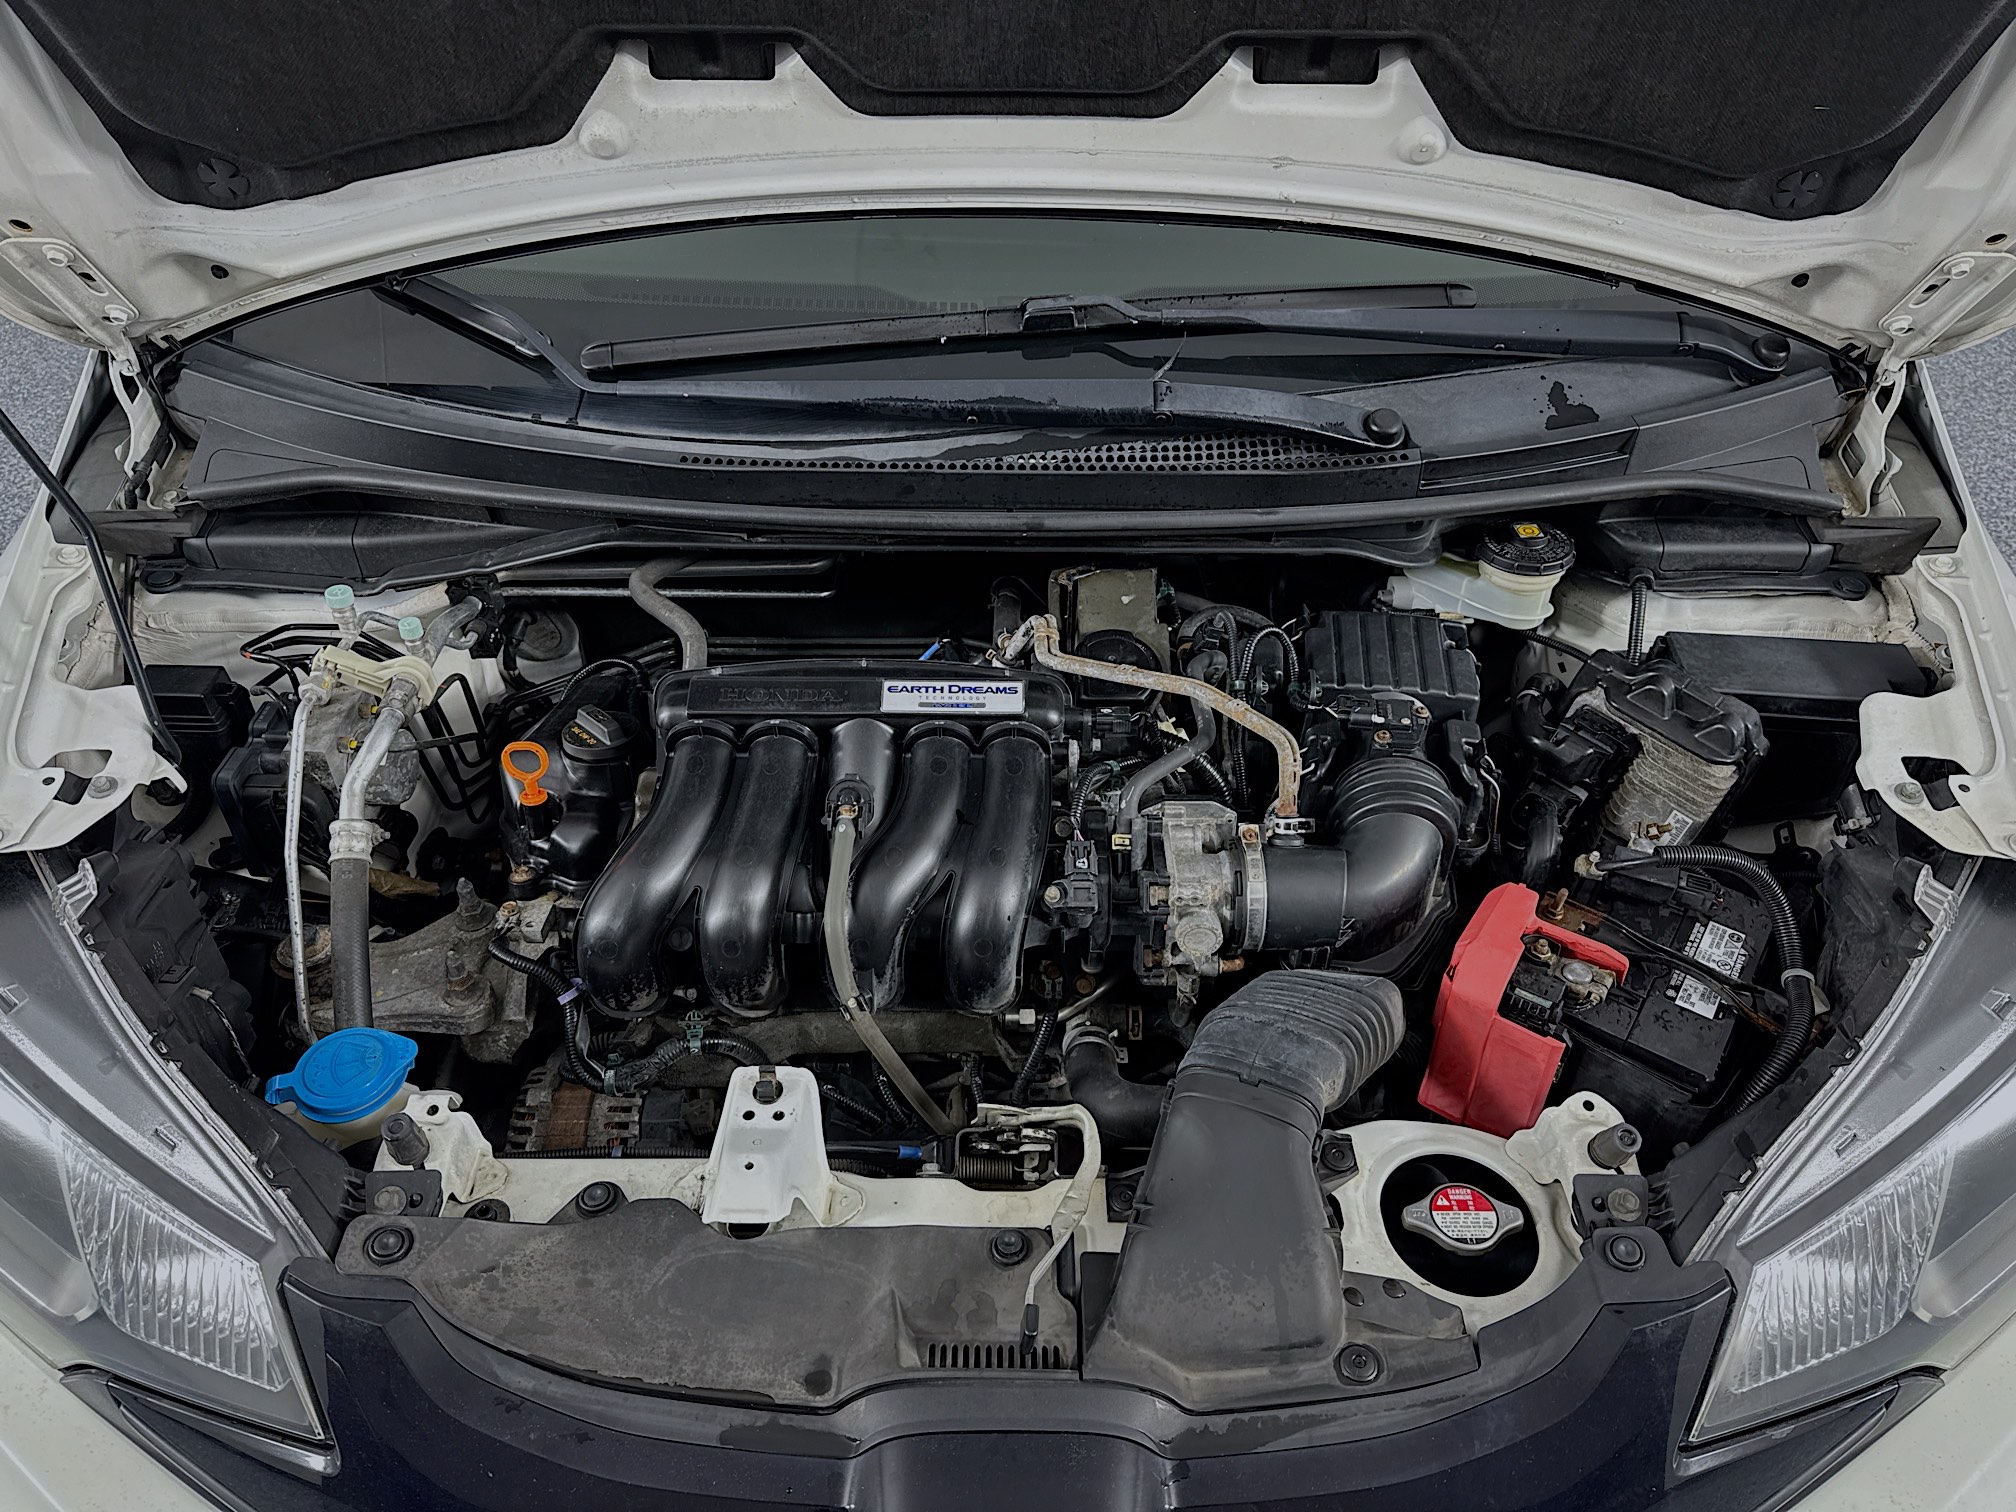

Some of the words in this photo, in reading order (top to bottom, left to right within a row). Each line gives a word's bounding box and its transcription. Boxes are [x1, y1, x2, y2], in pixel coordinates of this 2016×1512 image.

[719, 687, 844, 702] HONDA
[887, 685, 943, 694] EARTH
[948, 684, 1018, 695] DREAMS
